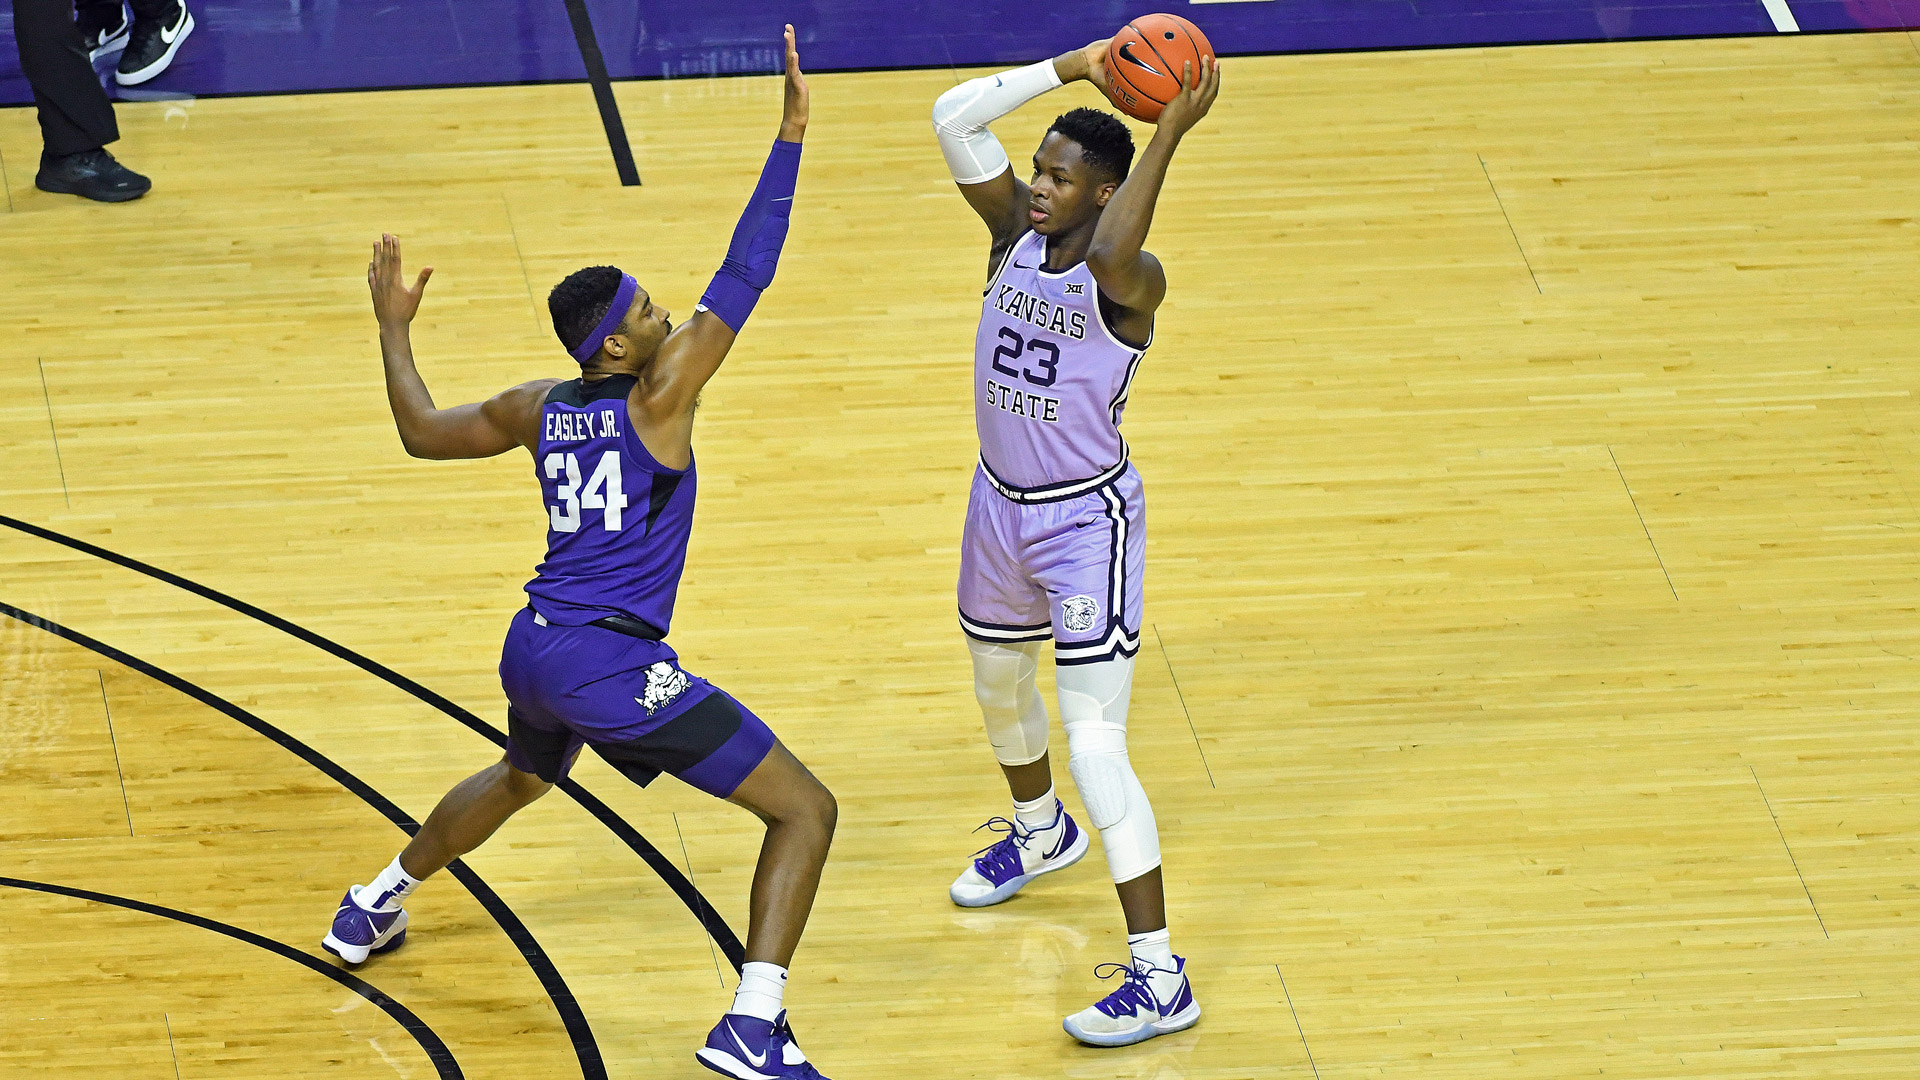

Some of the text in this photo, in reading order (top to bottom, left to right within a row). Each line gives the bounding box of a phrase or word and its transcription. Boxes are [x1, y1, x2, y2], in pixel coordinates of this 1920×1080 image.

[994, 283, 1087, 340] KANSAS
[992, 326, 1060, 387] 23
[546, 410, 620, 440] EASLEY JR.
[986, 379, 1060, 422] STATE
[544, 451, 628, 532] 34
